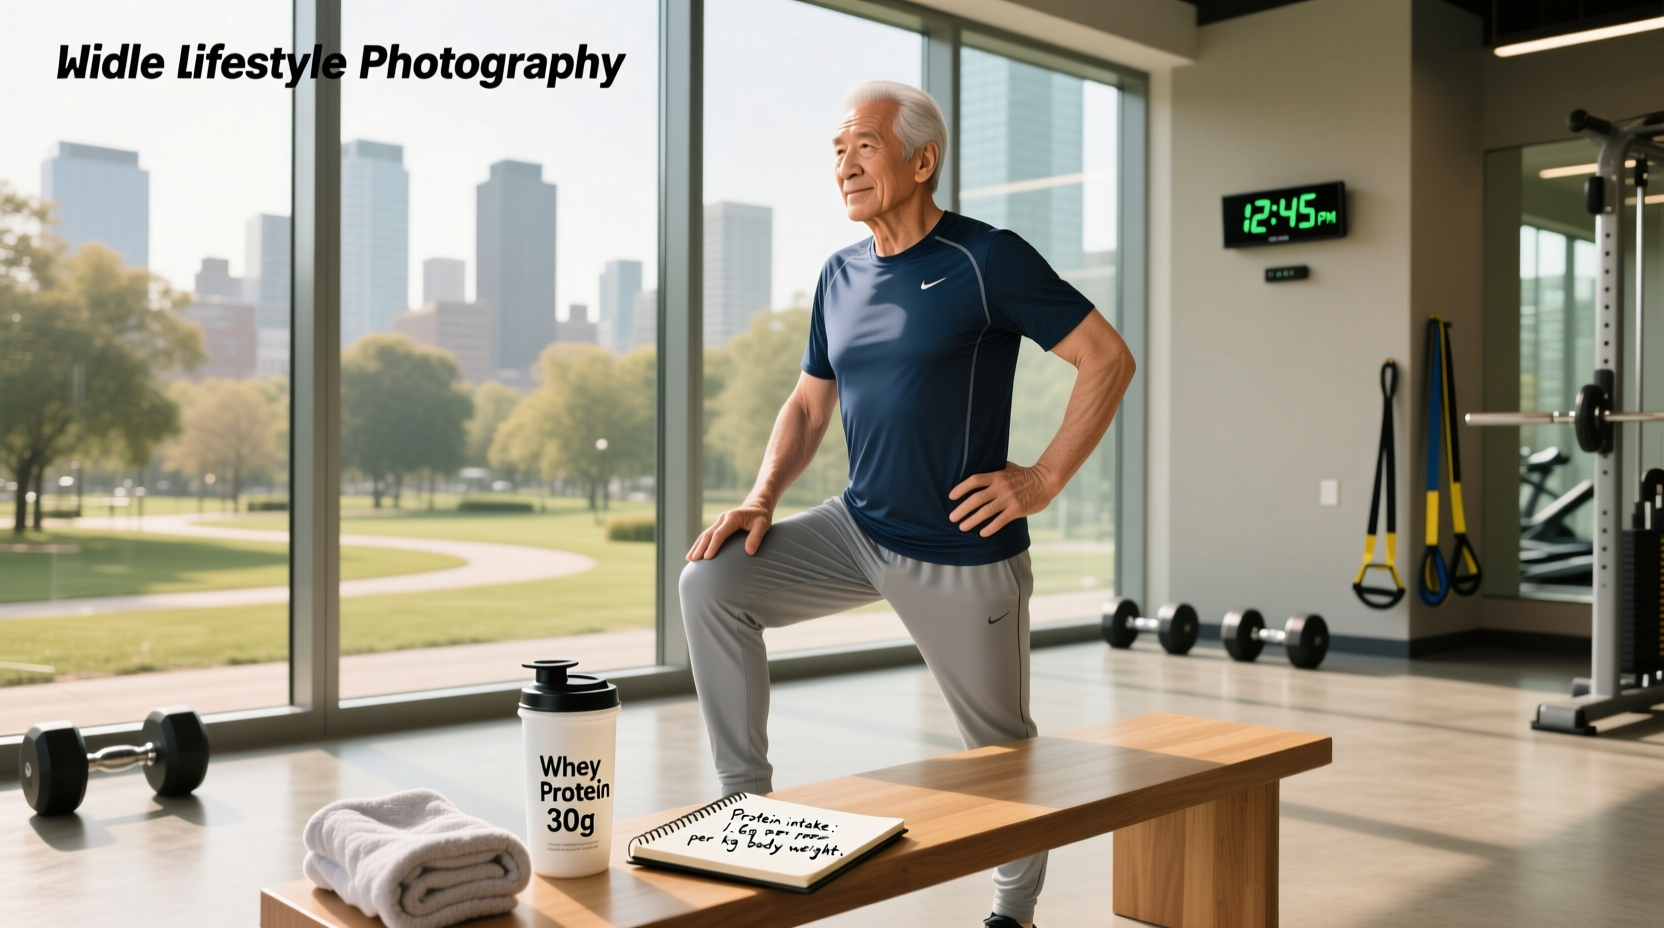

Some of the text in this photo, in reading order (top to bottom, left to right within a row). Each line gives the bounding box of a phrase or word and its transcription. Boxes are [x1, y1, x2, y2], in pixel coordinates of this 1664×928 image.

[1243, 192, 1337, 234] 12:45 PM
[539, 755, 602, 782] Whey
[540, 778, 610, 802] Protein
[546, 807, 596, 838] 30g
[730, 808, 839, 833] Protein intake:
[687, 834, 715, 846] per
[721, 835, 739, 852] kg
[747, 838, 783, 856] body
